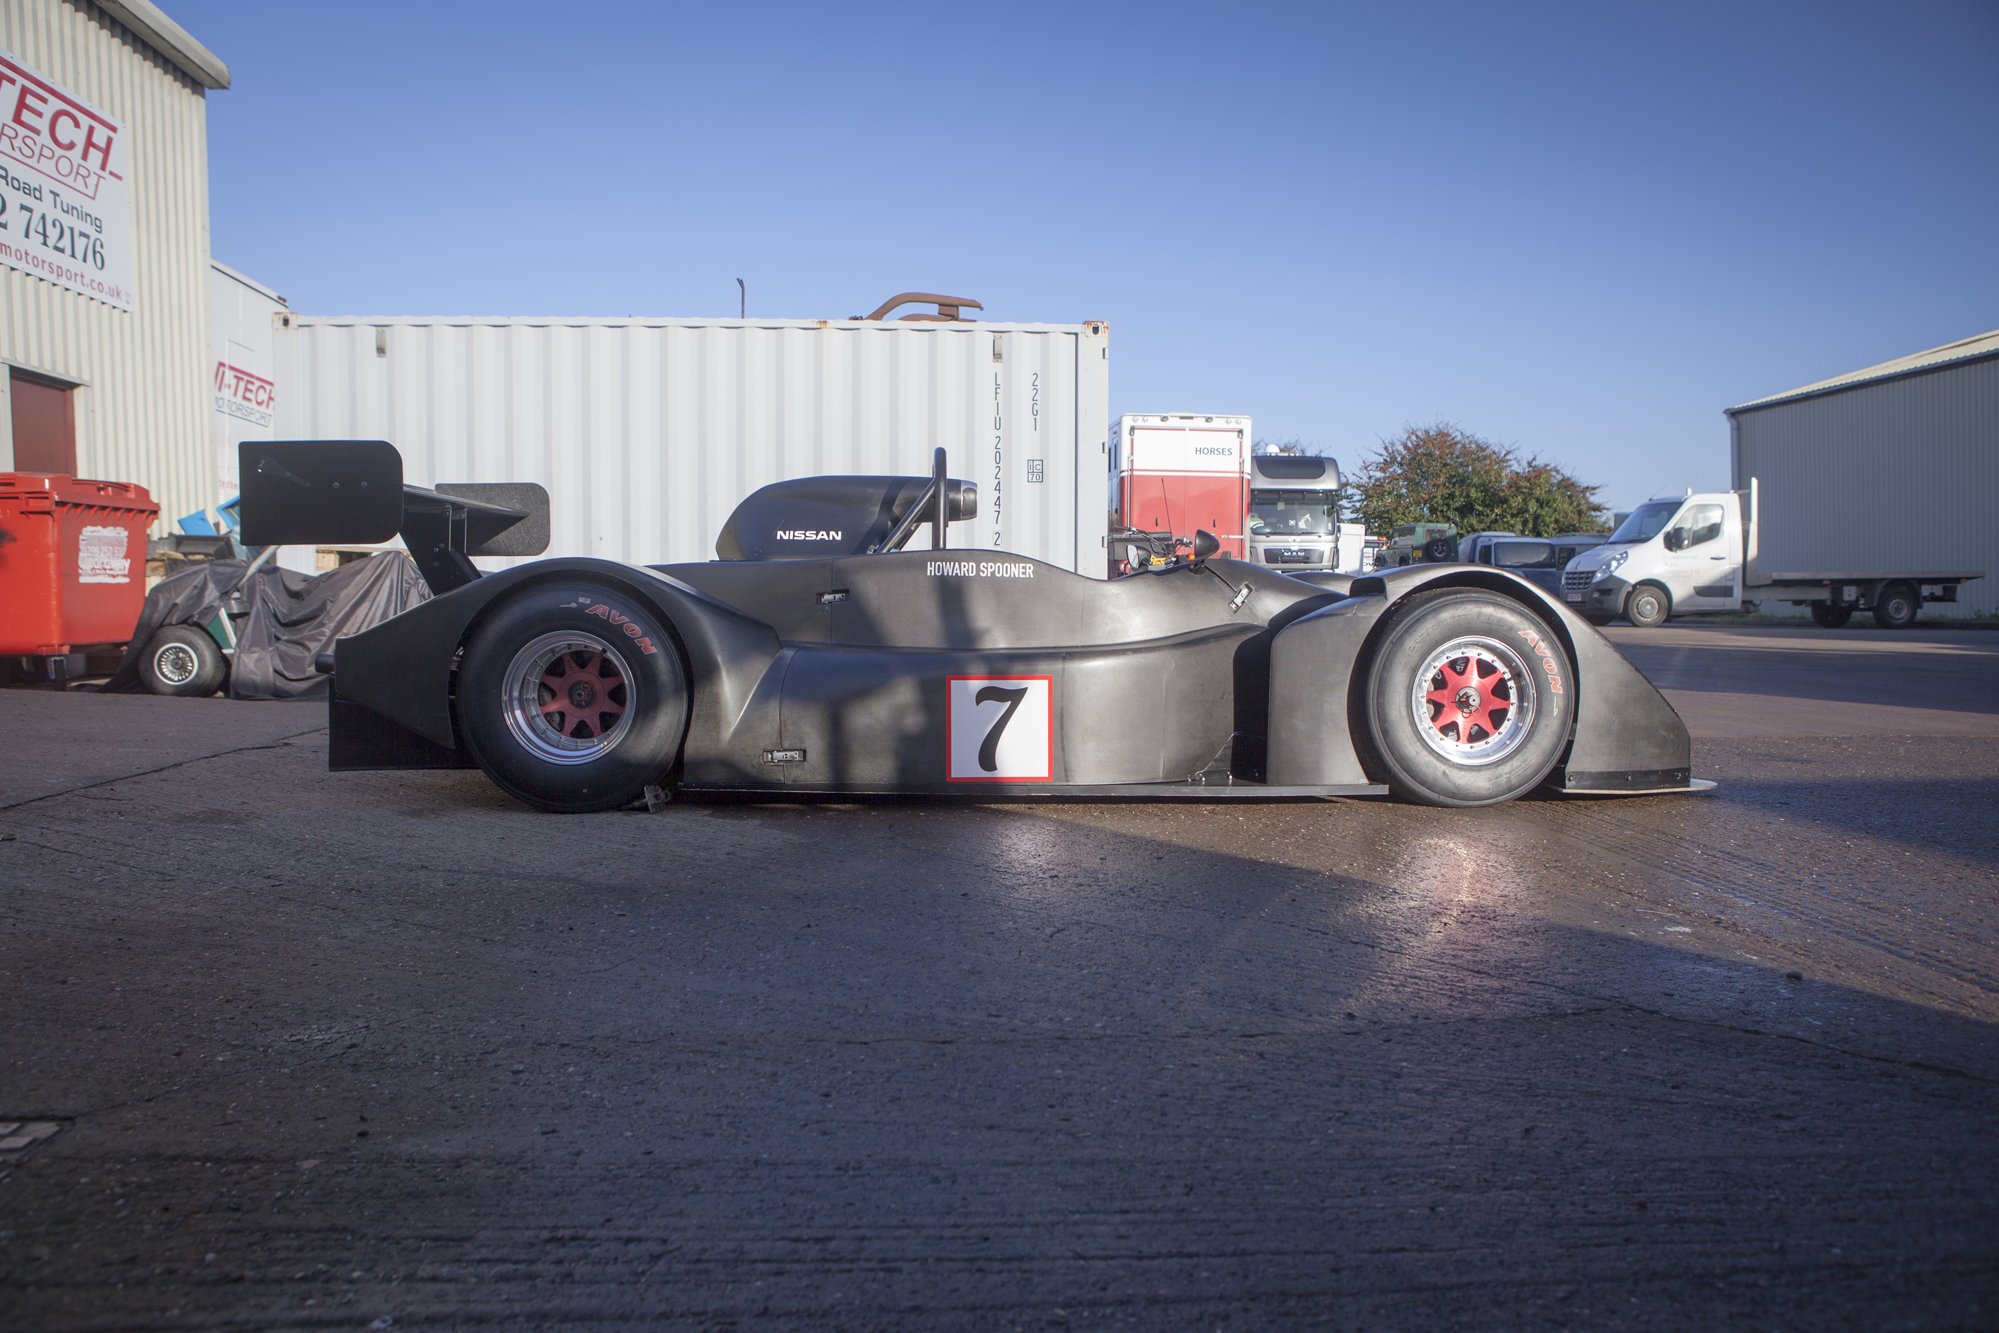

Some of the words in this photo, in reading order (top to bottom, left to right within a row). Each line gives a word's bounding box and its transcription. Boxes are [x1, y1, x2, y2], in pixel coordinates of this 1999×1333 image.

[19, 202, 105, 271] 742176
[49, 189, 103, 234] Tuning
[994, 372, 1002, 430] LFIU
[1031, 373, 1039, 431] 22G1
[994, 436, 1002, 524] 202447
[1195, 447, 1232, 456] HORSES
[776, 530, 842, 541] NISSAN
[927, 561, 977, 577] HOWARD
[979, 562, 1034, 578] SPOONER
[584, 603, 657, 655] AVON
[1517, 630, 1564, 694] AVON
[975, 685, 1029, 772] 7
